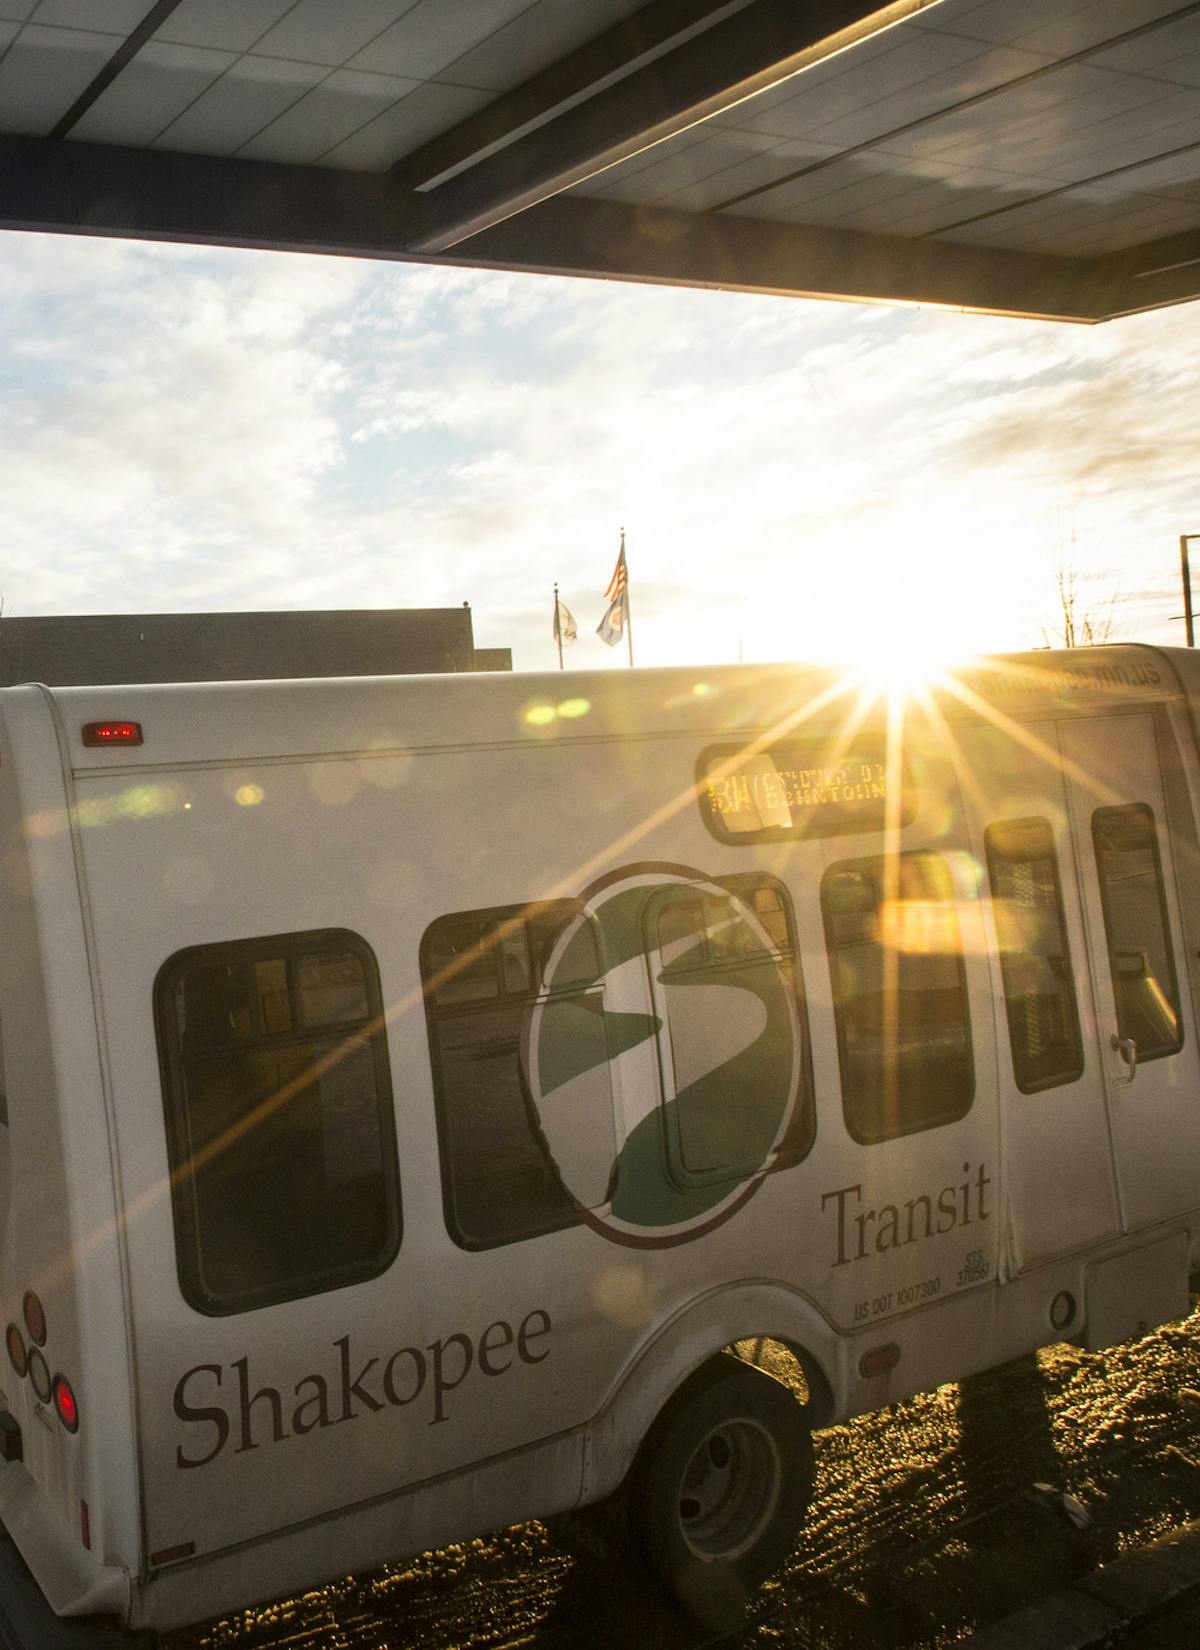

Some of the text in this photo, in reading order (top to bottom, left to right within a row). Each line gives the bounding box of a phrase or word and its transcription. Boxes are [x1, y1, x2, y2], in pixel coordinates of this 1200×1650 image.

[821, 1161, 992, 1269] Transit
[854, 1301, 870, 1321] US
[872, 1294, 894, 1315] DOT
[172, 1308, 553, 1470] Shakopee
